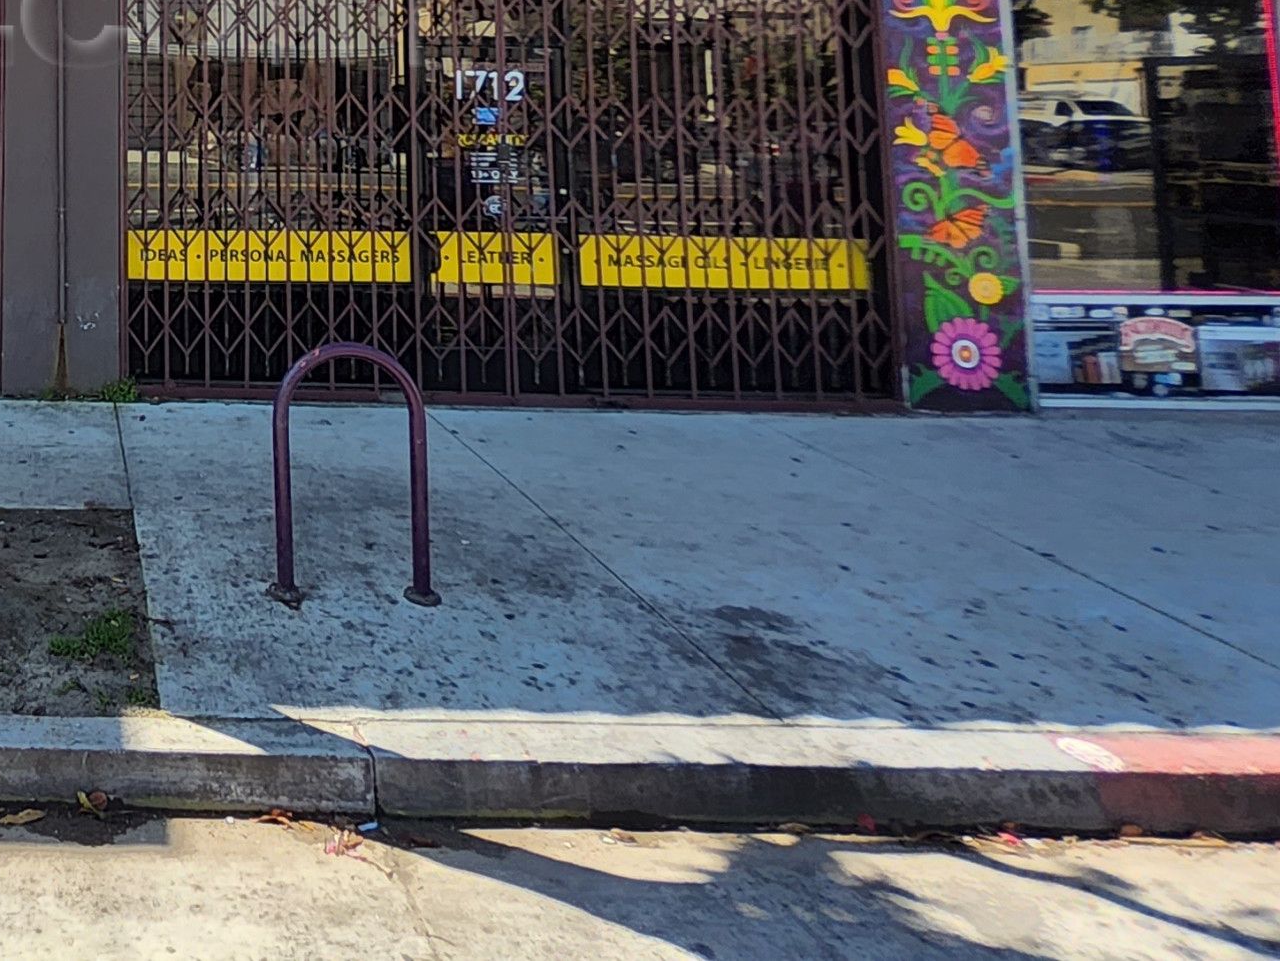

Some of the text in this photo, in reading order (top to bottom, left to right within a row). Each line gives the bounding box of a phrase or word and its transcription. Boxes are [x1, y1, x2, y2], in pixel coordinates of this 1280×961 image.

[455, 69, 525, 102] 1712
[140, 249, 400, 263] IDEAS PERSONAL MASSAGERS
